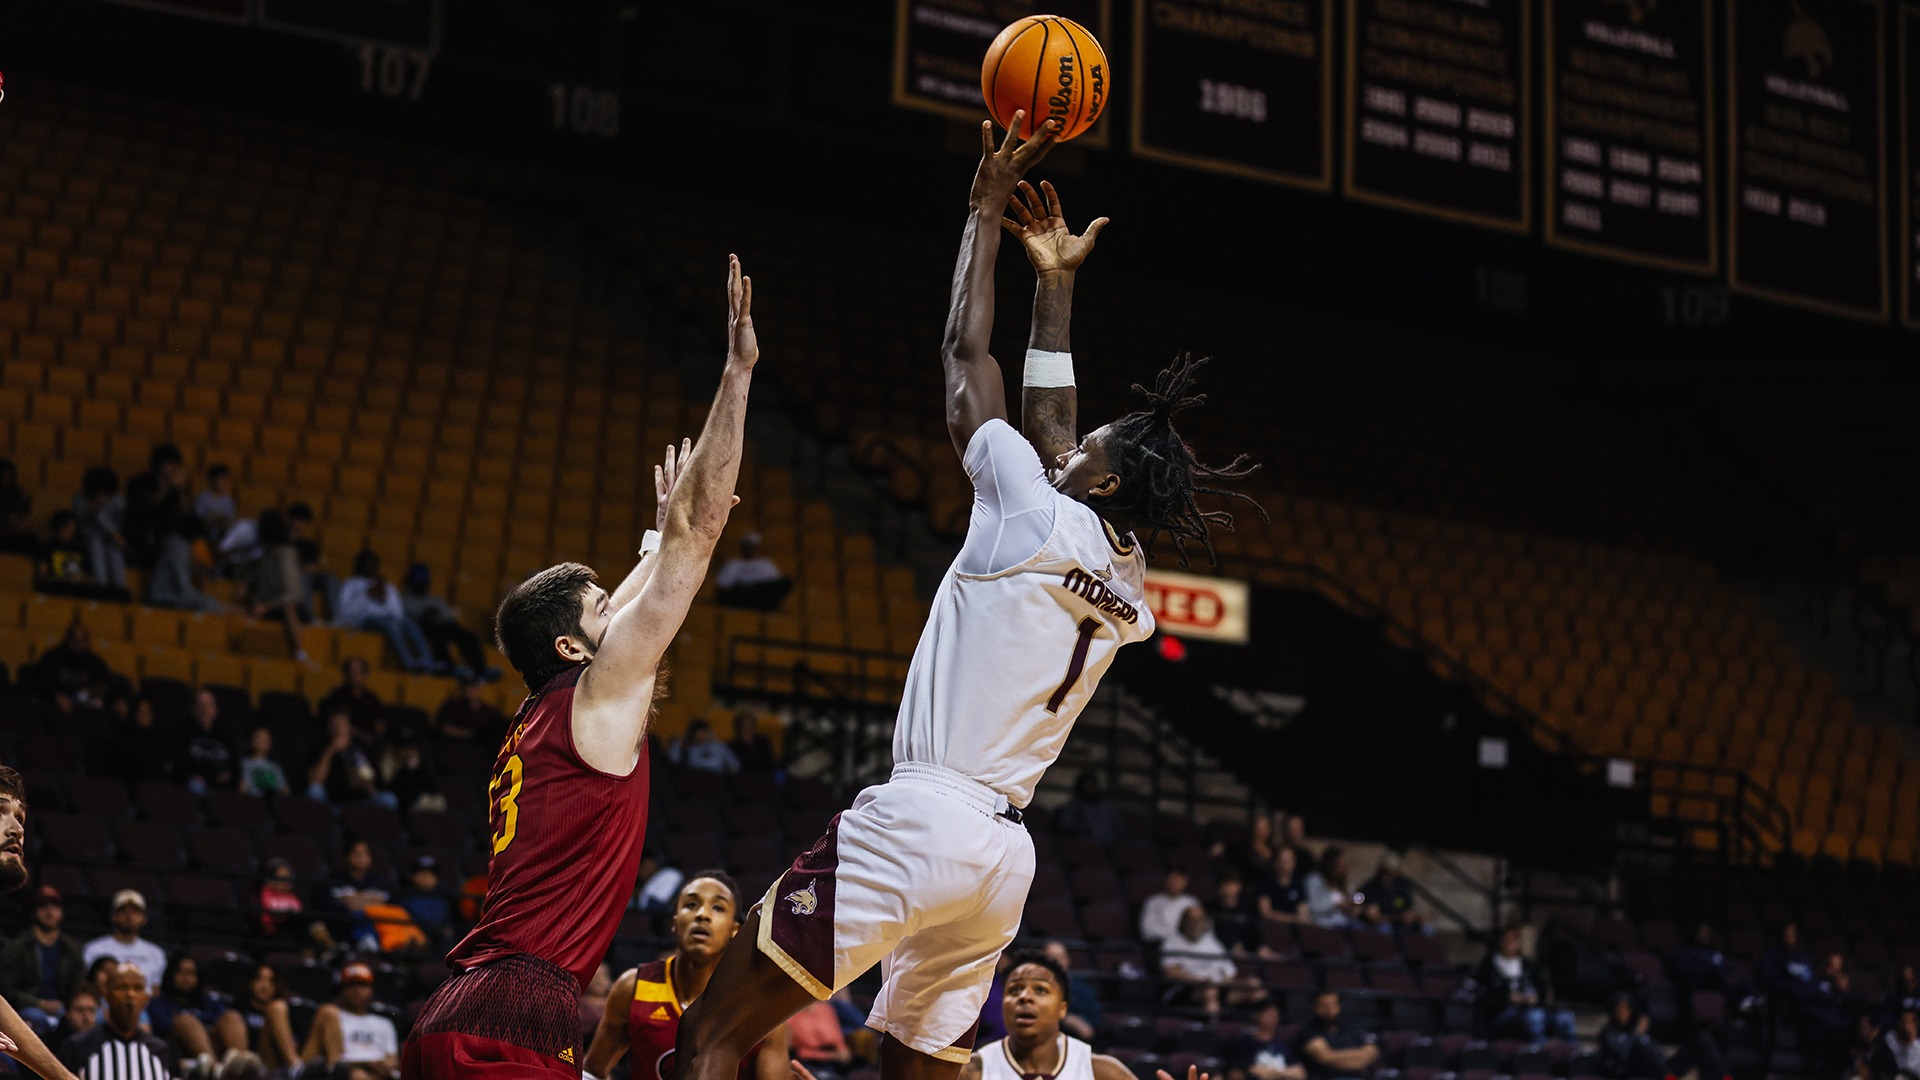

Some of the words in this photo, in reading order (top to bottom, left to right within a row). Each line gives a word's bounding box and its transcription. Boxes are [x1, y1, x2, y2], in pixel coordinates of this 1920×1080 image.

[354, 42, 431, 102] 107
[1046, 55, 1074, 136] Wilson
[1044, 614, 1105, 717] 1
[488, 753, 524, 858] 3
